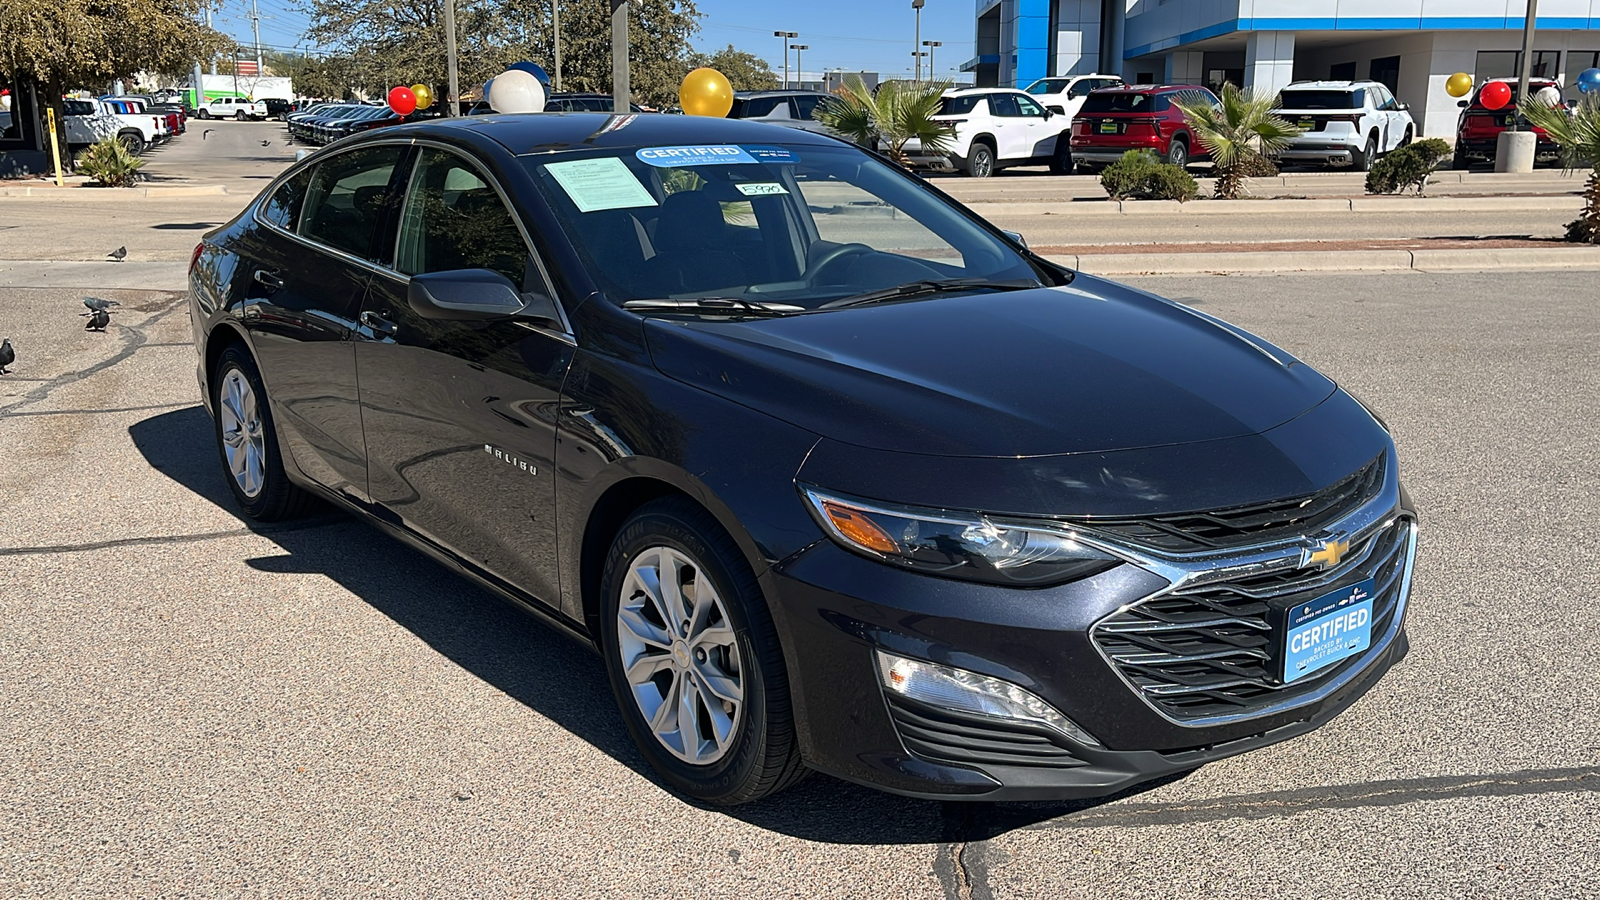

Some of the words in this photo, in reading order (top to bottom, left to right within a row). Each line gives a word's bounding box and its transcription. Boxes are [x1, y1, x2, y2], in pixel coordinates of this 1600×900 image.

[641, 147, 740, 159] CERTIFIED
[484, 444, 537, 476] MALIBU
[1290, 608, 1369, 654] CERTIFIED
[1313, 640, 1335, 654] BACKED
[1335, 636, 1344, 645] BY
[1295, 650, 1326, 669] CHEVROLET
[1326, 643, 1344, 656] BUICK
[1348, 636, 1361, 647] GMC
